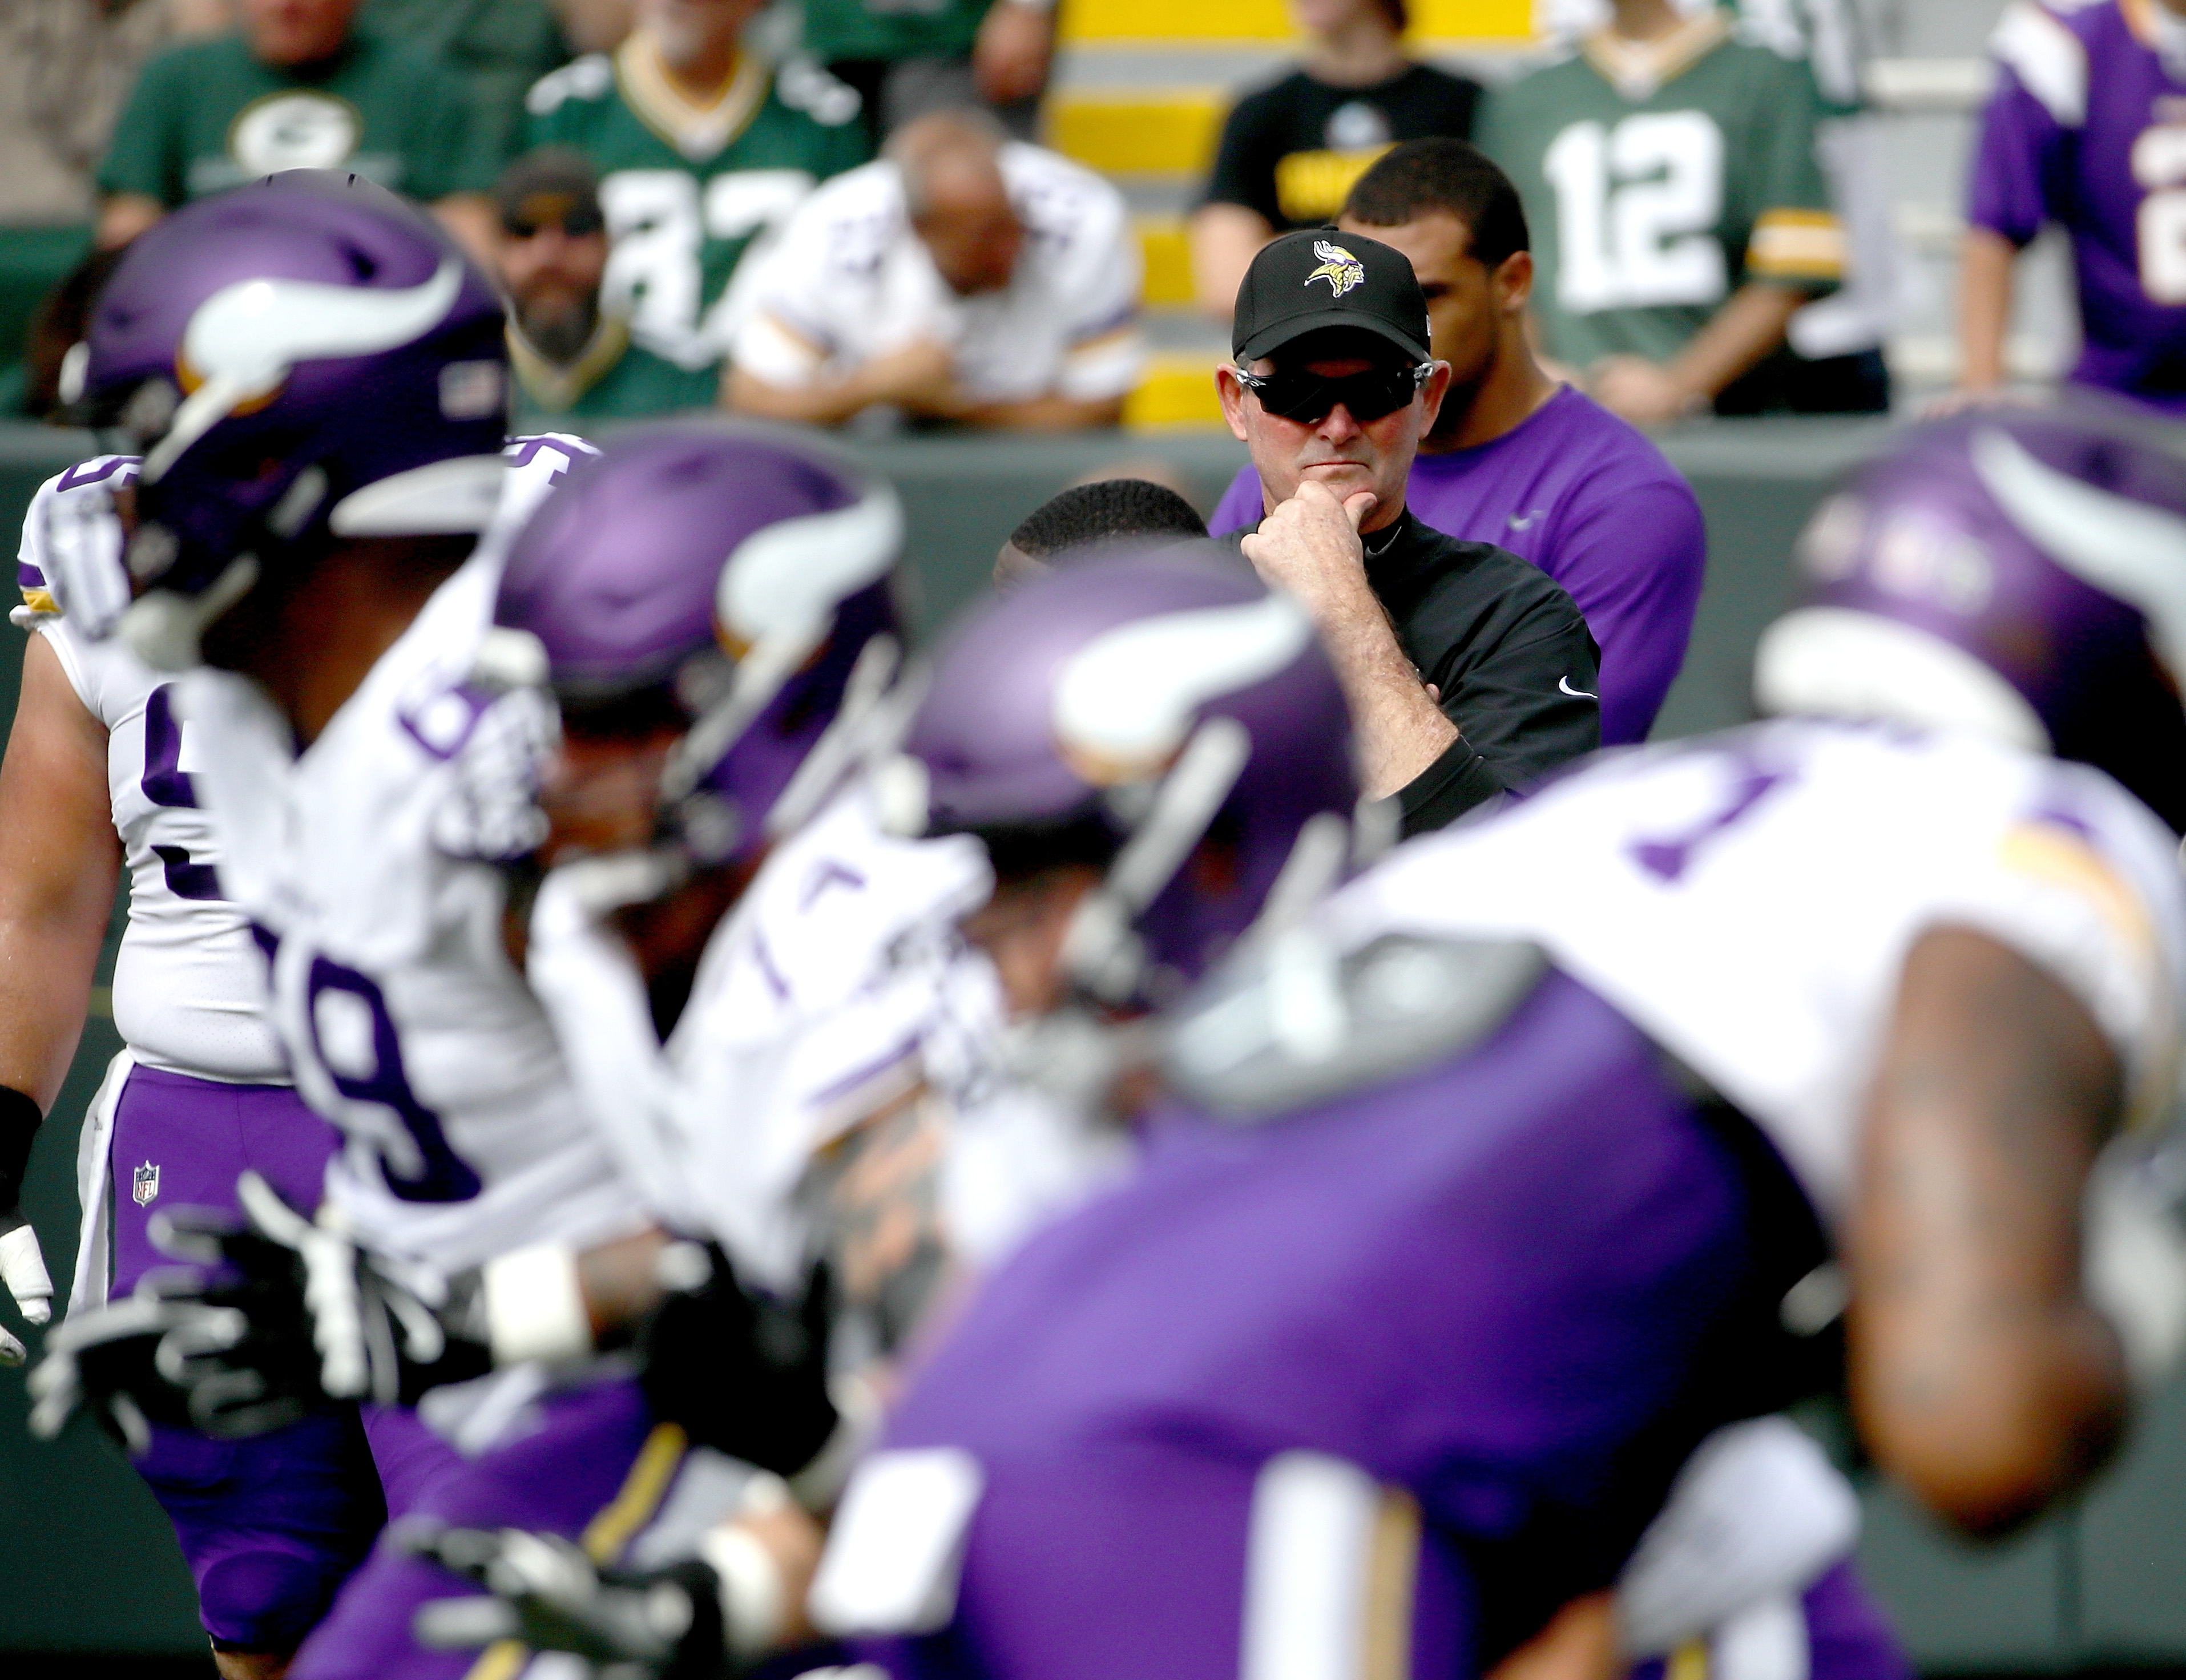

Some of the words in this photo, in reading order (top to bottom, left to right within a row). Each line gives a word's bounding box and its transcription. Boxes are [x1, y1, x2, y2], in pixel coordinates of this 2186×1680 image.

[598, 169, 817, 370] 87
[1543, 110, 1728, 312] 12
[136, 1181, 154, 1200] NFL
